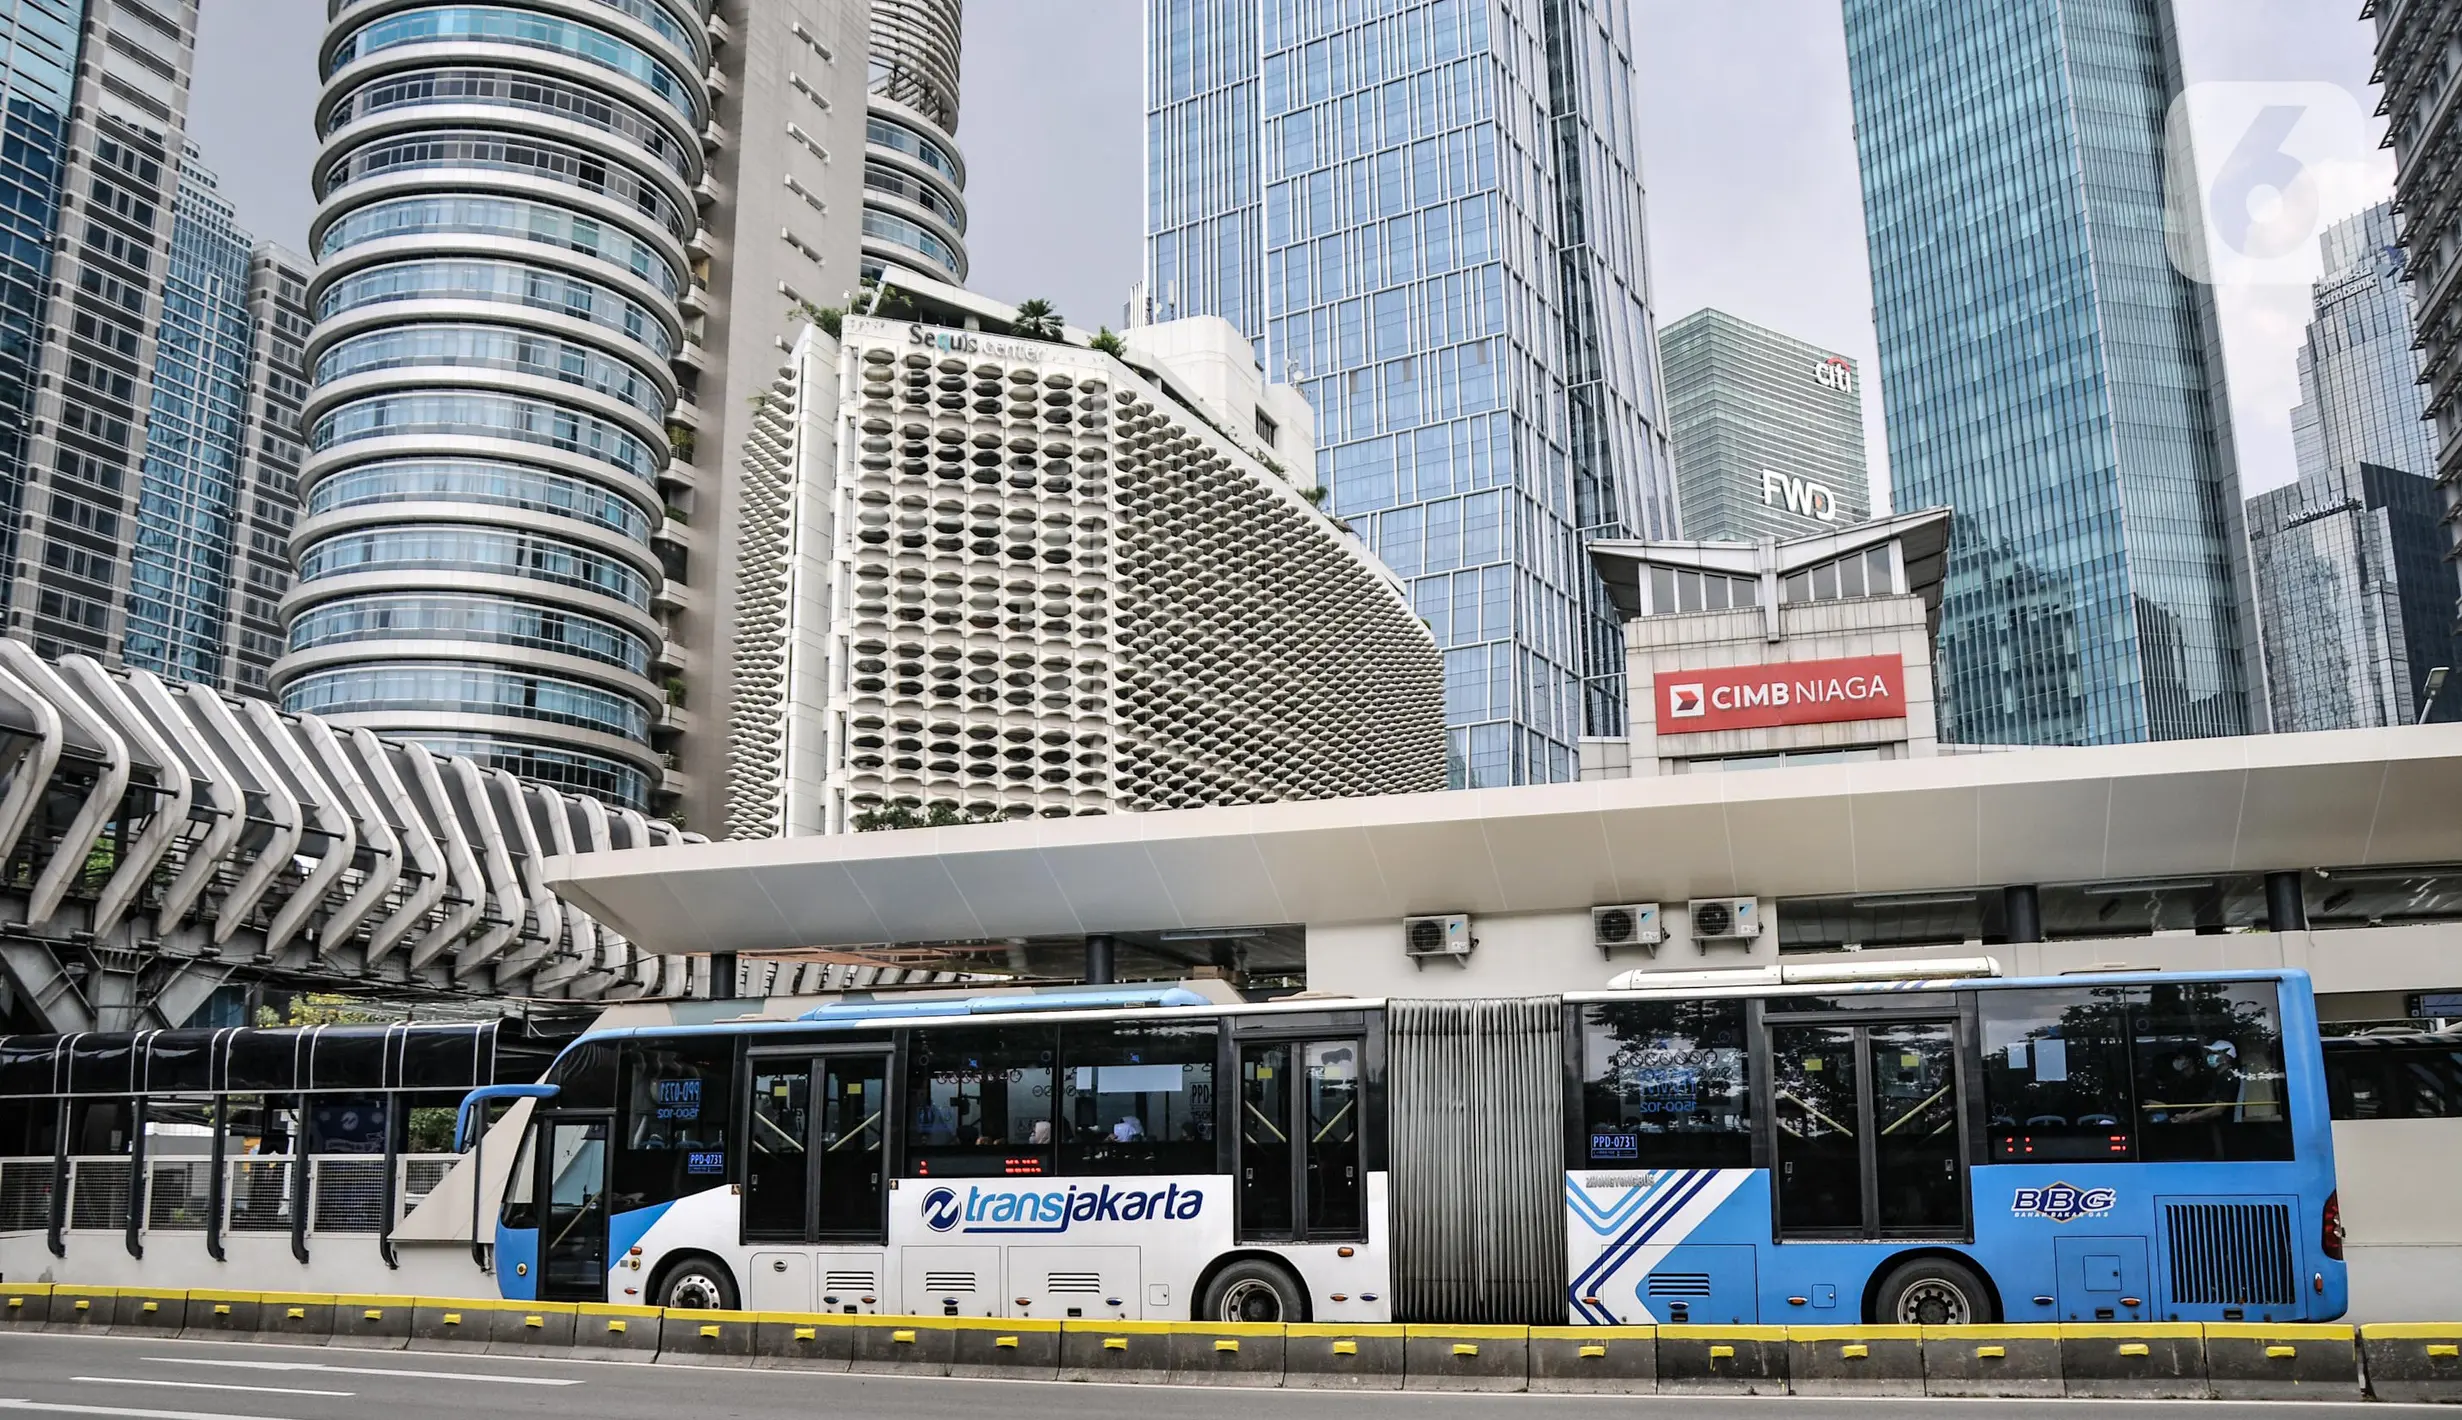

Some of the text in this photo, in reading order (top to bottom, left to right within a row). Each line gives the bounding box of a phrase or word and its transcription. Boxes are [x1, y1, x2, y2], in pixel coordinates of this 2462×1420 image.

[909, 323, 1045, 362] Sequis center
[1814, 357, 1852, 393] citi
[1761, 468, 1836, 521] FWD
[2286, 493, 2348, 524] wework
[1711, 674, 1890, 710] CIMB NIAGA
[690, 1154, 722, 1165] PPD-0731
[1593, 1135, 1635, 1148] PPD-0731
[963, 1183, 1204, 1233] transjakarta
[2011, 1188, 2117, 1212] BBG
